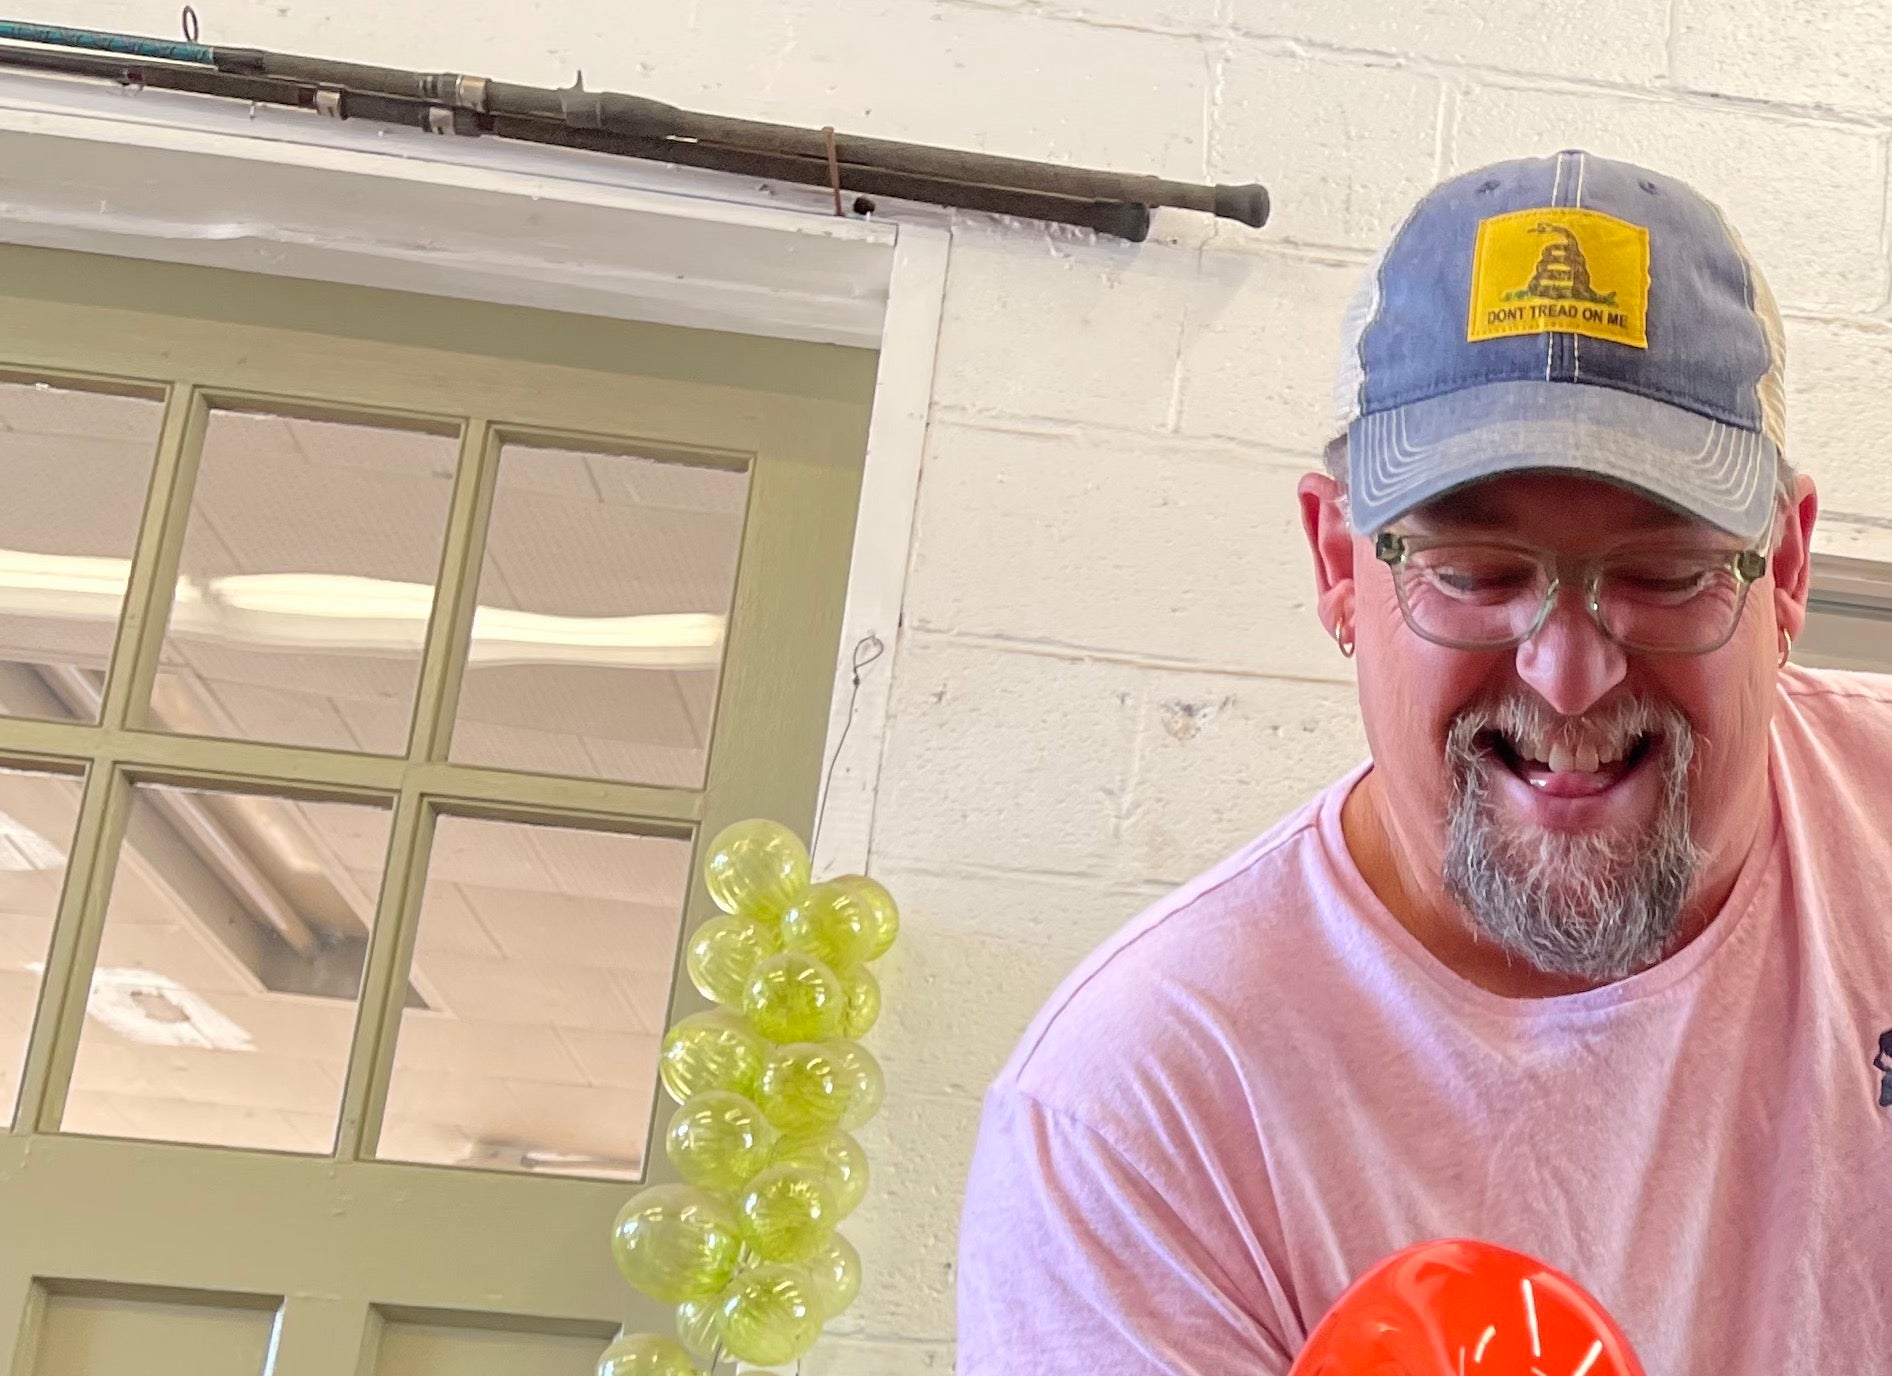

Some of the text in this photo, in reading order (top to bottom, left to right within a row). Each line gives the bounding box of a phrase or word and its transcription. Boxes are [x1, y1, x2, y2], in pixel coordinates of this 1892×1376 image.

[1488, 304, 1628, 328] DONT TREAD ON ME
